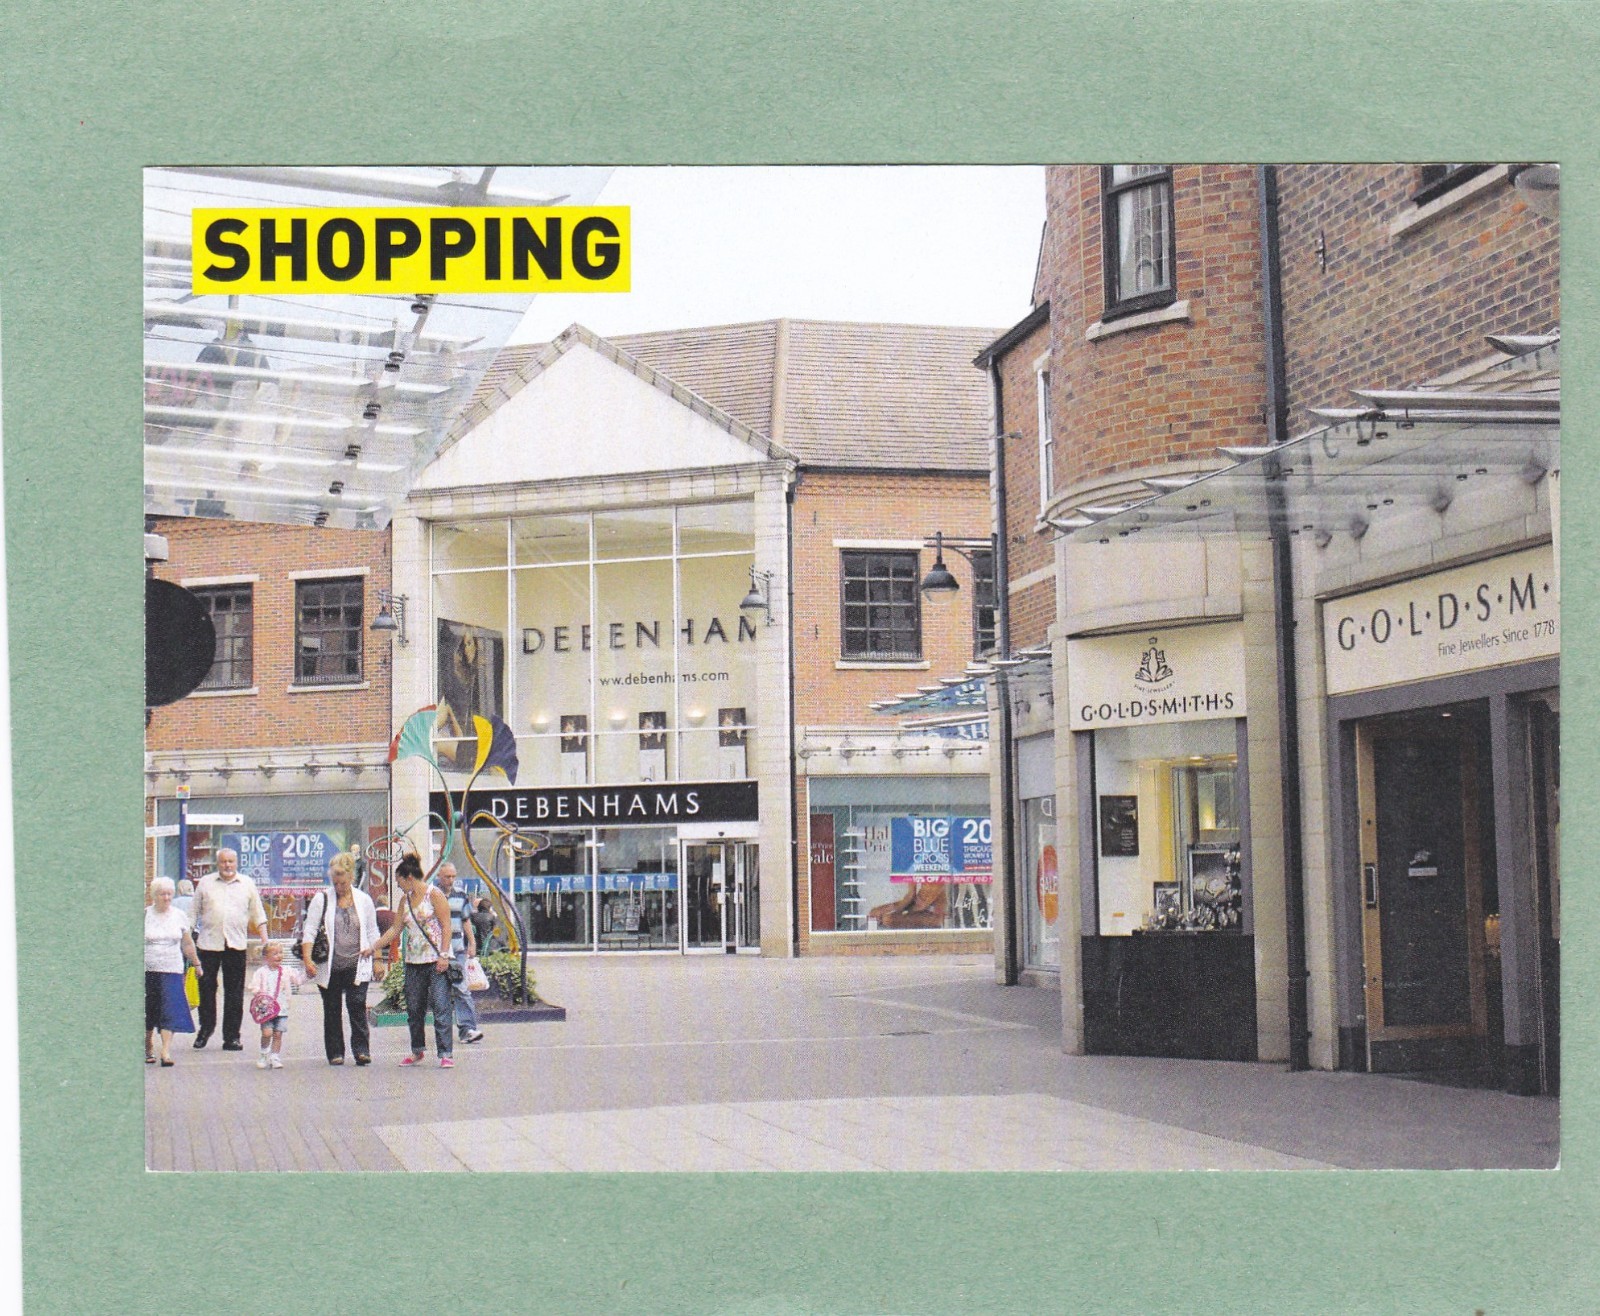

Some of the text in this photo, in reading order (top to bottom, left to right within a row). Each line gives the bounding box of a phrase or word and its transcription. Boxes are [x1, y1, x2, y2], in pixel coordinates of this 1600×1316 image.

[1438, 619, 1555, 657] Fine Jewellers Since 1778
[587, 671, 730, 687] ww.debenhms.com
[491, 791, 702, 820] DEBENHAMS
[913, 819, 949, 838] BIG
[962, 819, 992, 844] 20
[240, 835, 271, 852] BIG
[282, 834, 324, 858] 20%
[913, 838, 949, 853] BLUE
[240, 853, 270, 867] BLUE
[913, 853, 949, 863] CROSS
[913, 863, 950, 871] WEEKEND
